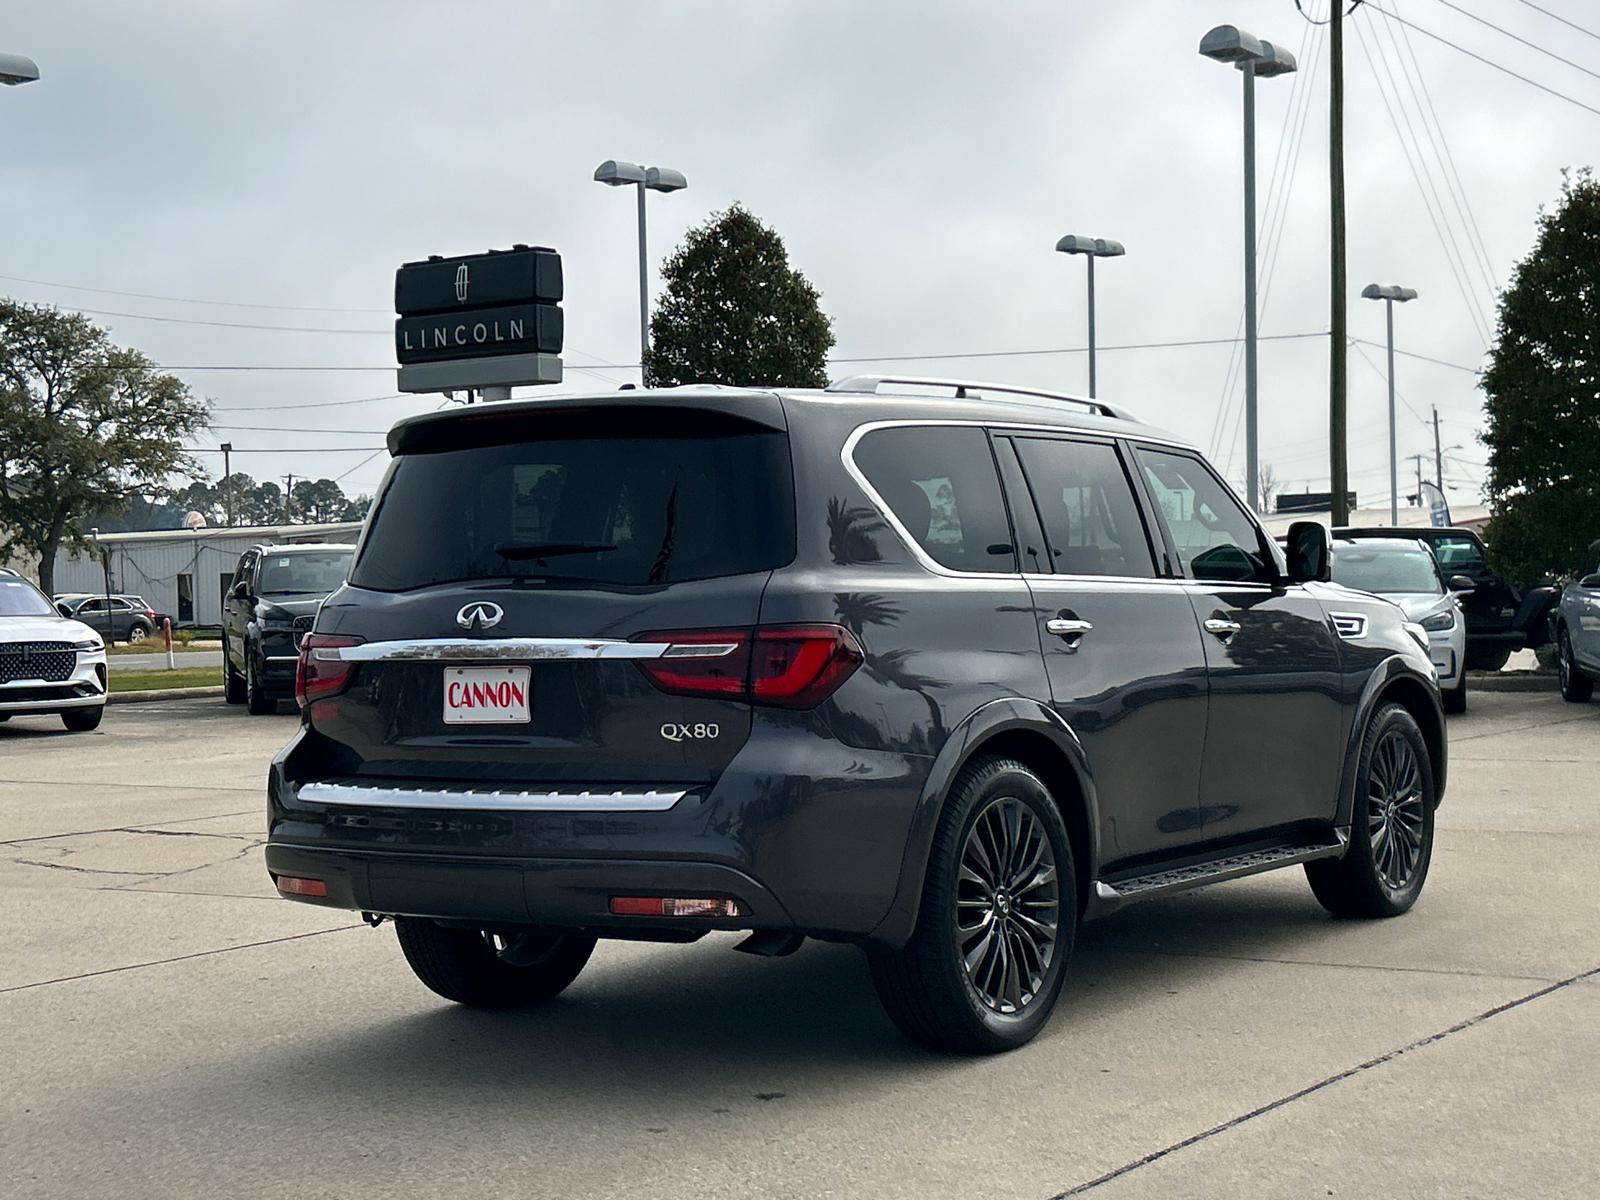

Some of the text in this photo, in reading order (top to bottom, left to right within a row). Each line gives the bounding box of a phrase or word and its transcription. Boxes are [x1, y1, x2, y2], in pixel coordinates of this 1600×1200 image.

[404, 319, 524, 350] LINCOLN
[448, 681, 525, 708] CANNON
[660, 723, 720, 742] QX80
